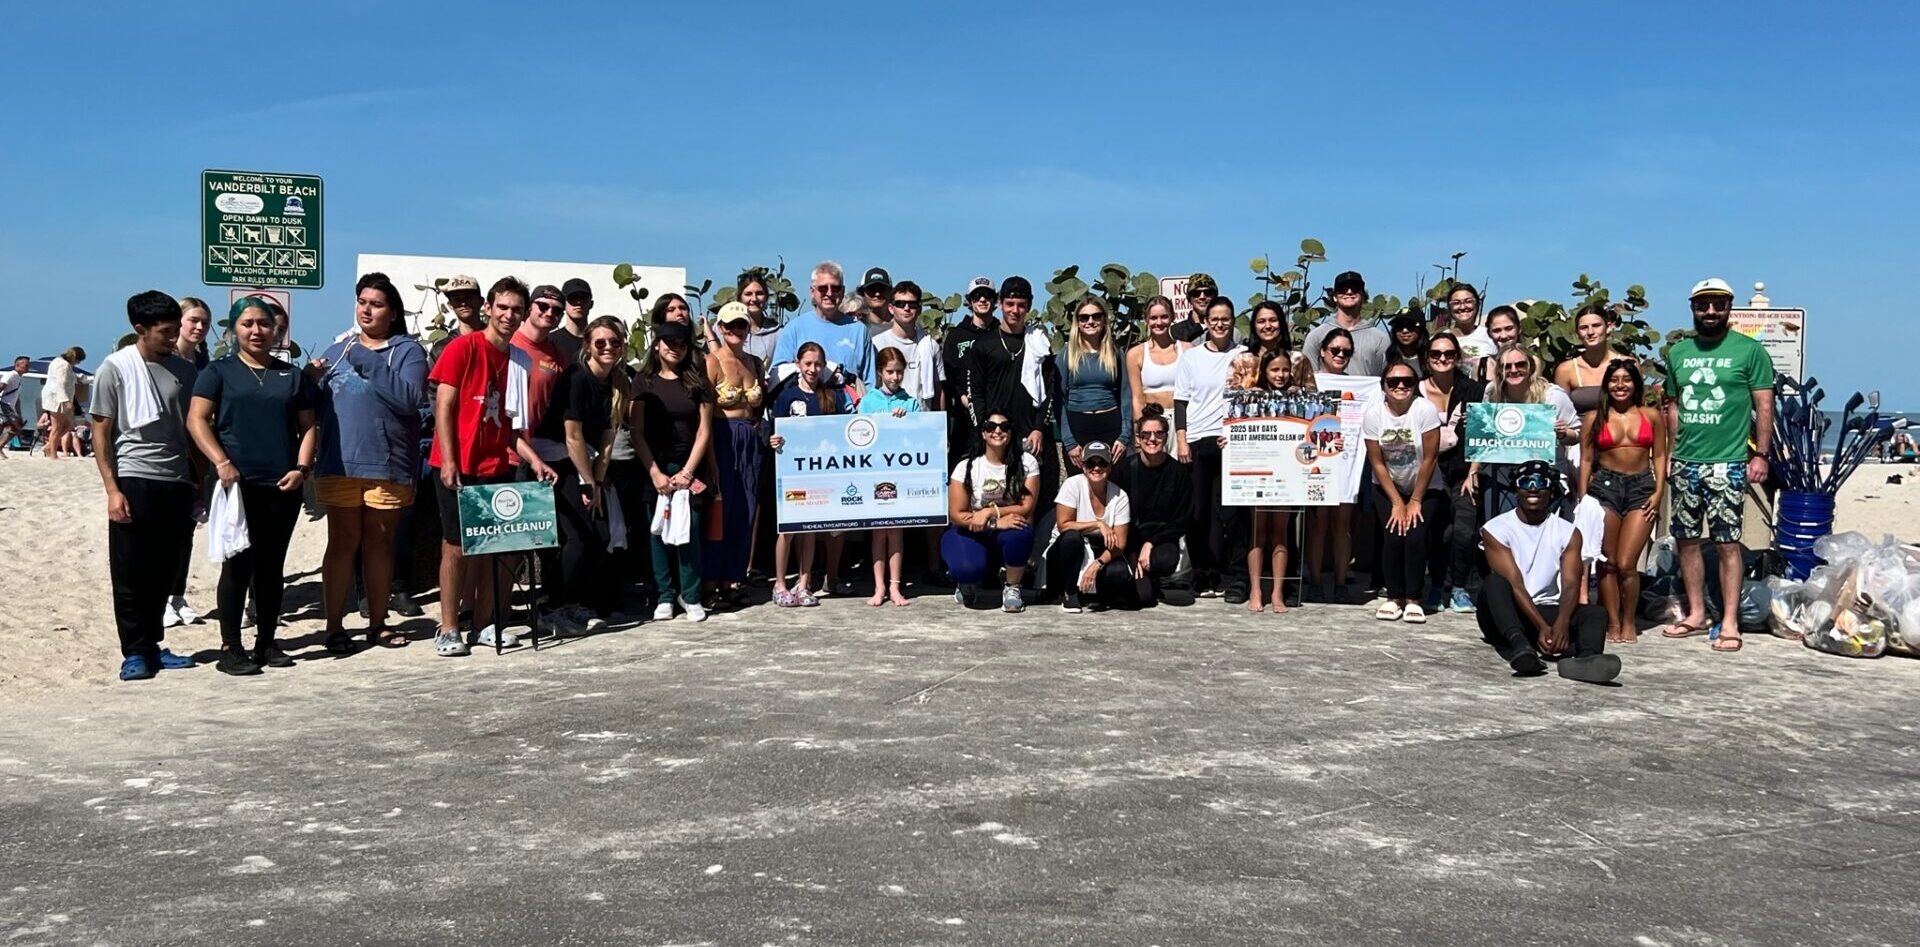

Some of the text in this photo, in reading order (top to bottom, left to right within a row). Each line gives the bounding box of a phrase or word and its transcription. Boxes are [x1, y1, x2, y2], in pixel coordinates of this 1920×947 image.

[232, 175, 263, 183] WELCOME
[209, 181, 317, 196] VANDERBILT BEACH
[222, 214, 244, 222] OPEN
[270, 216, 280, 224] TO
[222, 266, 308, 277] NO ALCOHOL PERMITTED
[1682, 357, 1733, 369] DON'T BE
[1683, 412, 1722, 425] TRASHY
[1230, 424, 1278, 433] 2025 BAY DAYS
[1230, 433, 1306, 442] GREAT AMERICAN CLEAN UP
[1468, 438, 1552, 449] BEACH CLEANUP
[794, 452, 929, 471] THANK YOU
[465, 521, 553, 537] BEACH CLEANUP
